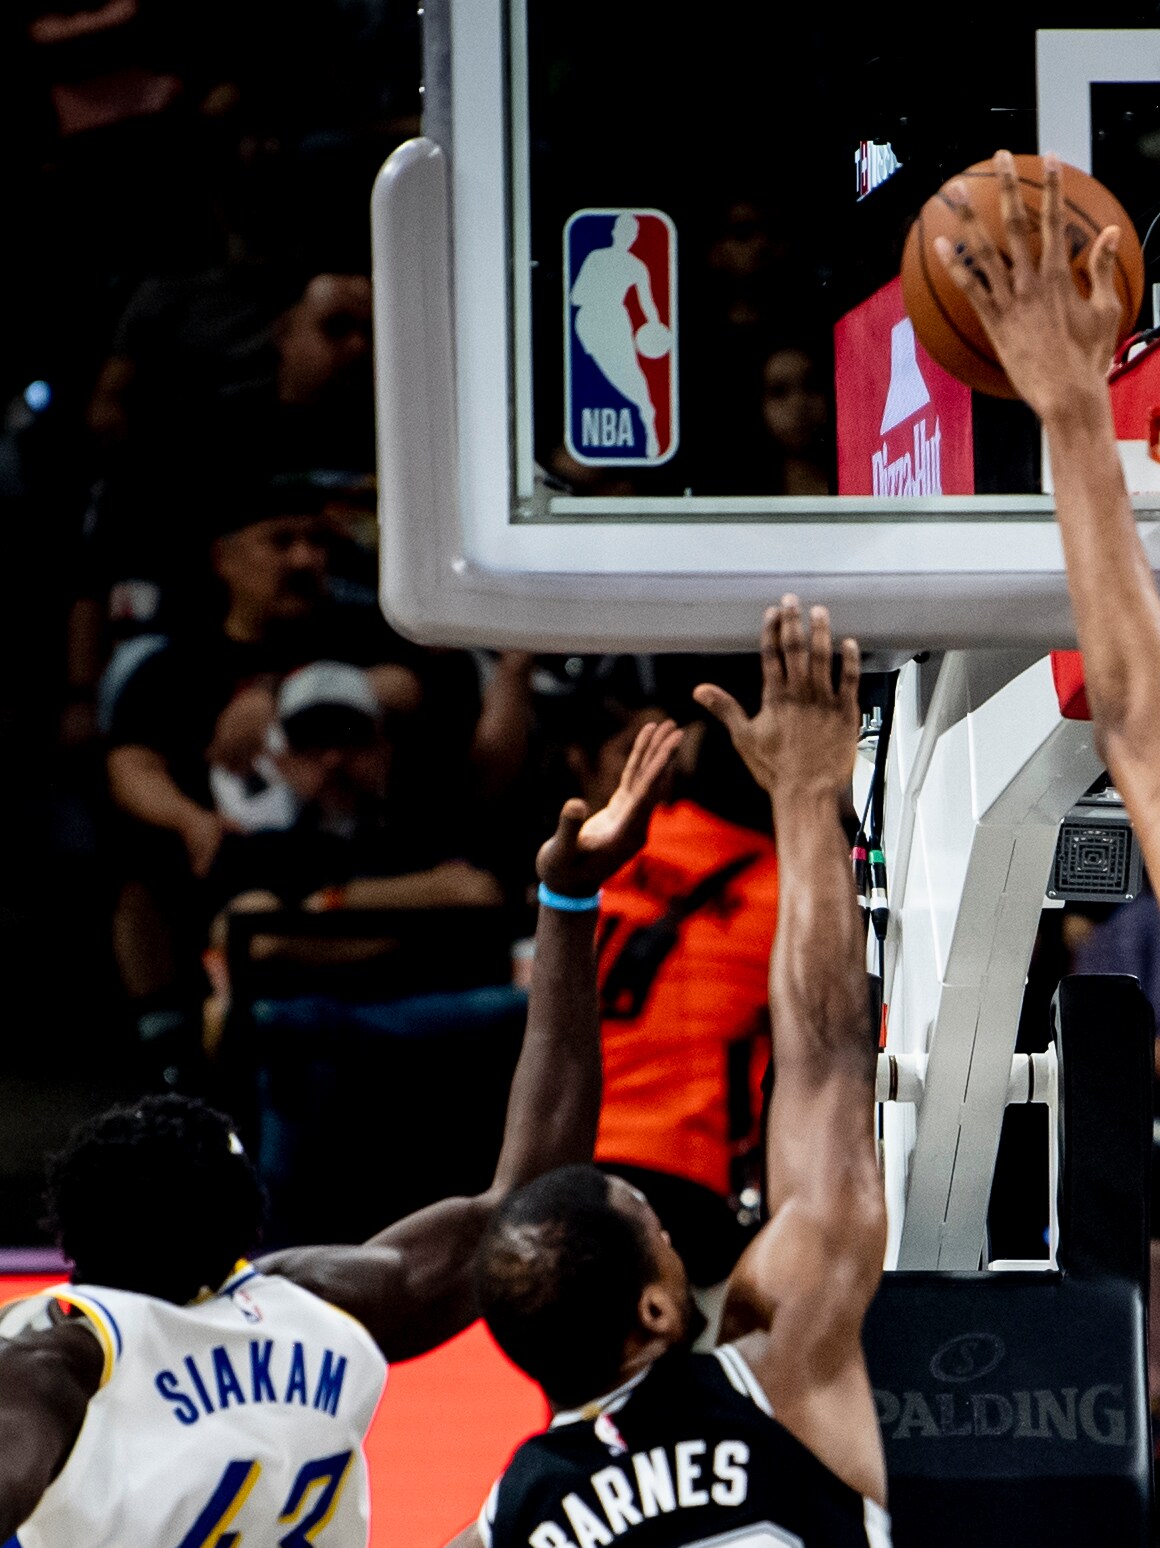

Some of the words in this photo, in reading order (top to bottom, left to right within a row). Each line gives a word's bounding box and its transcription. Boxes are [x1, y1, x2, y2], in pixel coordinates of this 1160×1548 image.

[581, 407, 636, 448] NBA
[154, 1339, 348, 1425] SIAKAM
[873, 1383, 1126, 1447] PALDING
